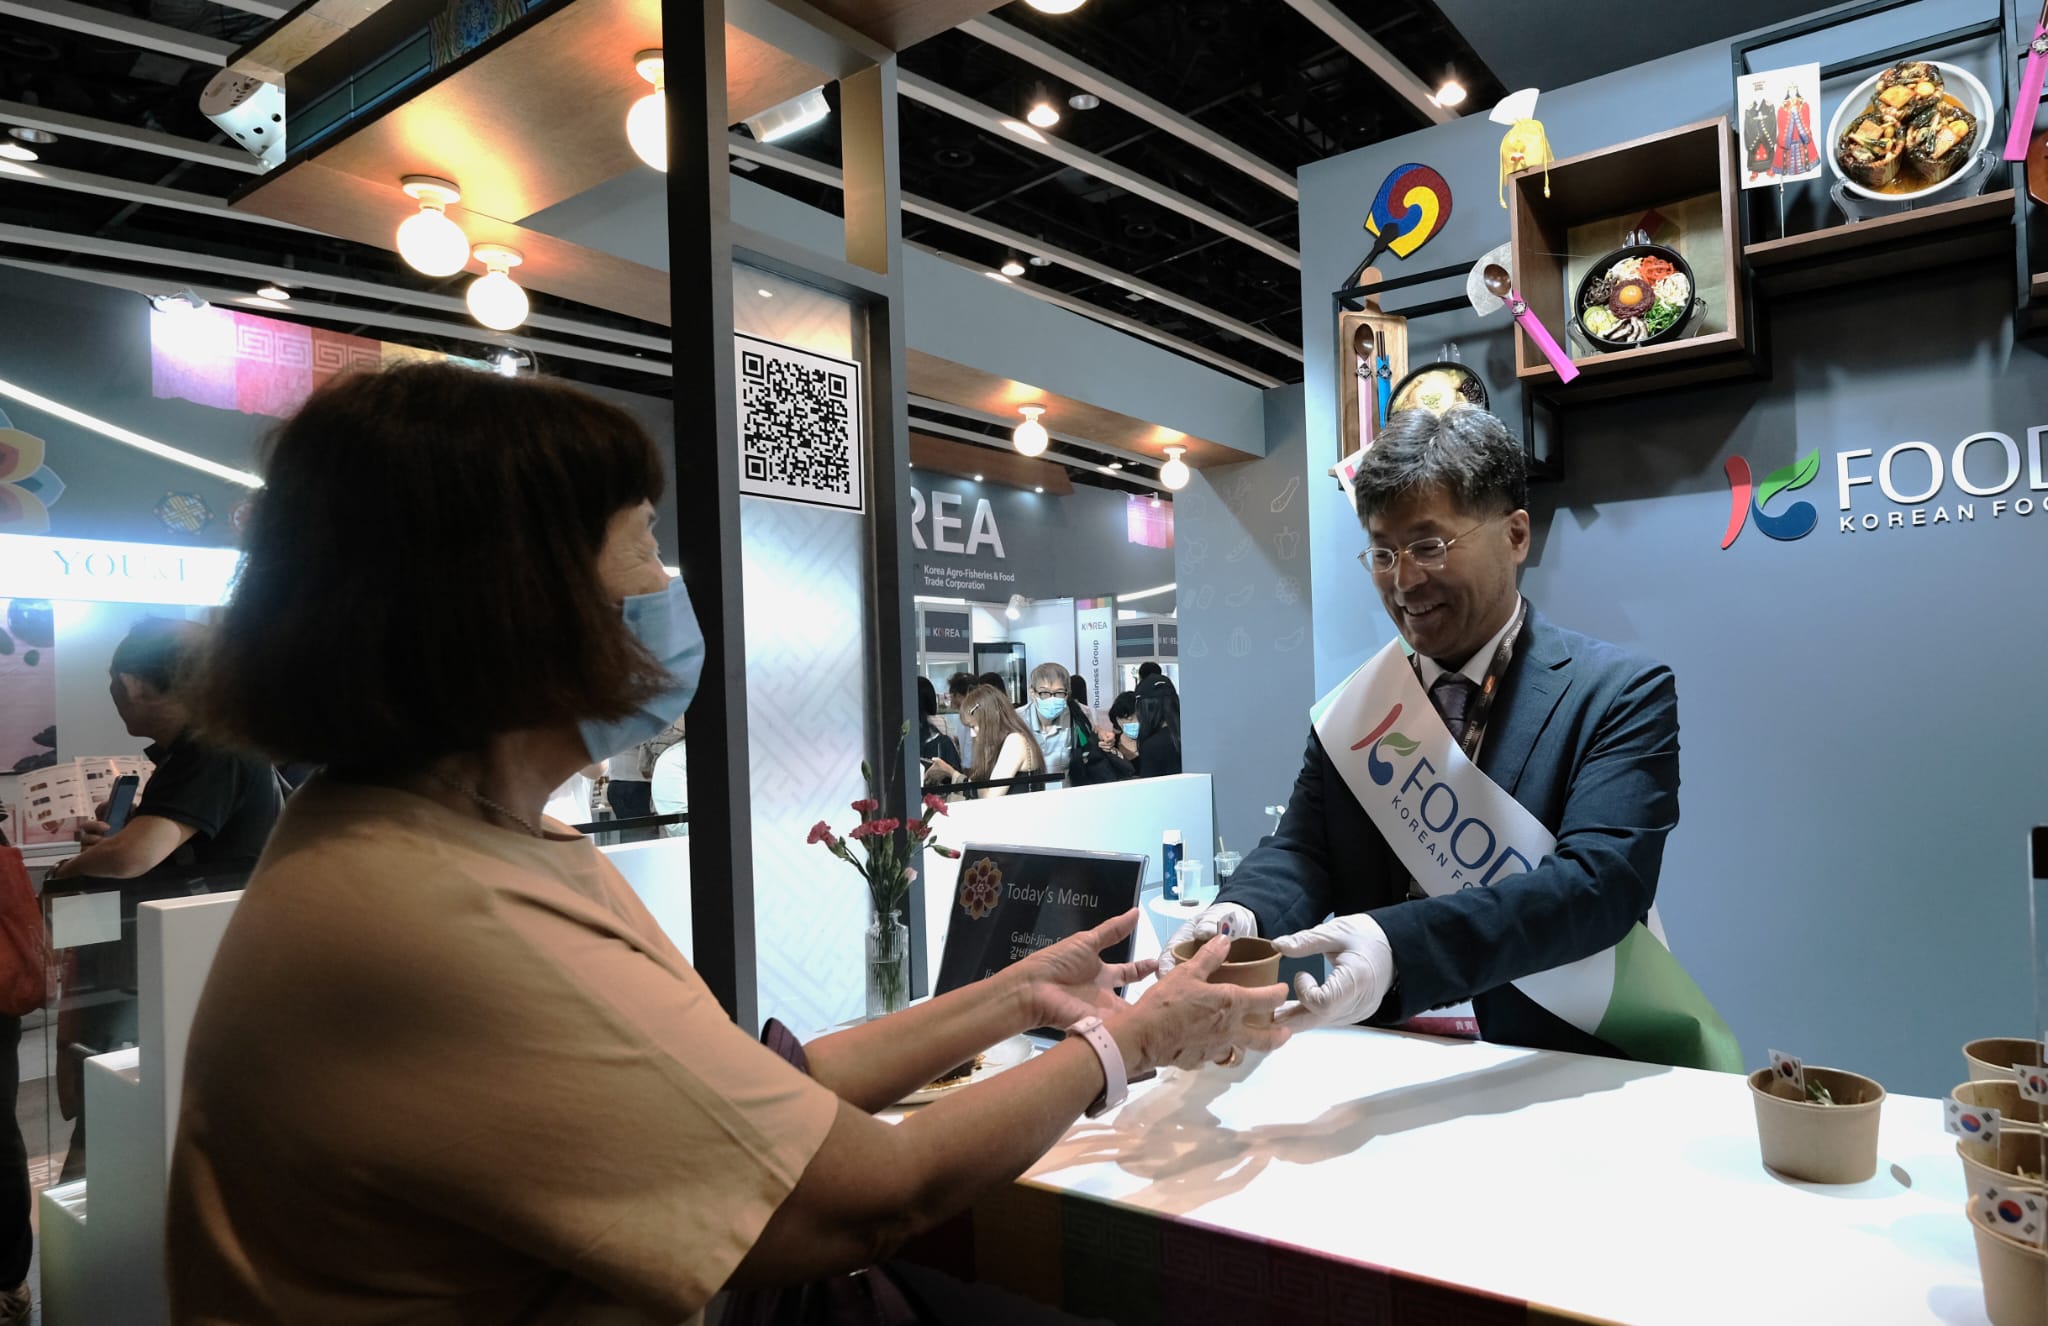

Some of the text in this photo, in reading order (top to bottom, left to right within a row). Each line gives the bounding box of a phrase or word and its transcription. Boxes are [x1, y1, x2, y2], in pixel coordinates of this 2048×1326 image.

[1839, 504, 1974, 532] KOREAN
[924, 564, 1015, 583] Korea Agro-Fisheries & Food
[924, 576, 985, 592] Trade Corporation
[1092, 639, 1100, 666] Group
[1391, 795, 1449, 867] KOREAN
[1400, 756, 1533, 888] FOOD
[1007, 883, 1099, 908] Today's Menu
